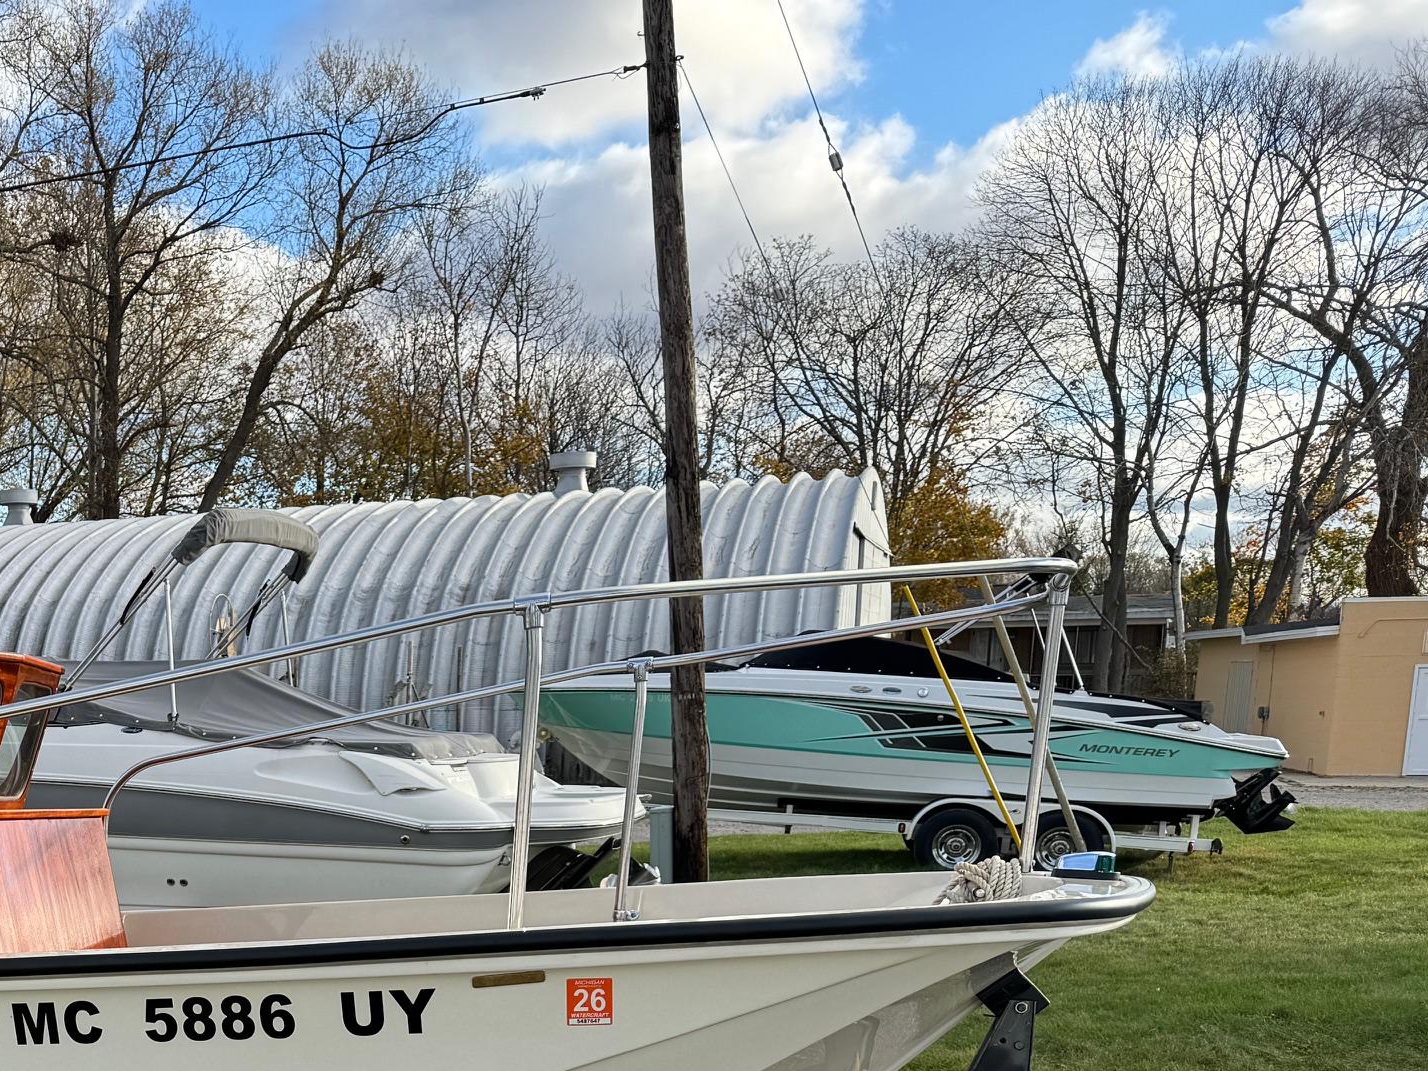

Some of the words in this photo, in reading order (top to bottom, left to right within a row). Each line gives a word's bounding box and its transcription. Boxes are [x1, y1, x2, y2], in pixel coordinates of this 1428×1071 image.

[1079, 743, 1180, 757] MONTEREY
[573, 988, 606, 1012] 26
[10, 1000, 103, 1046] MC
[144, 993, 296, 1043] 5886
[339, 987, 437, 1037] UY
